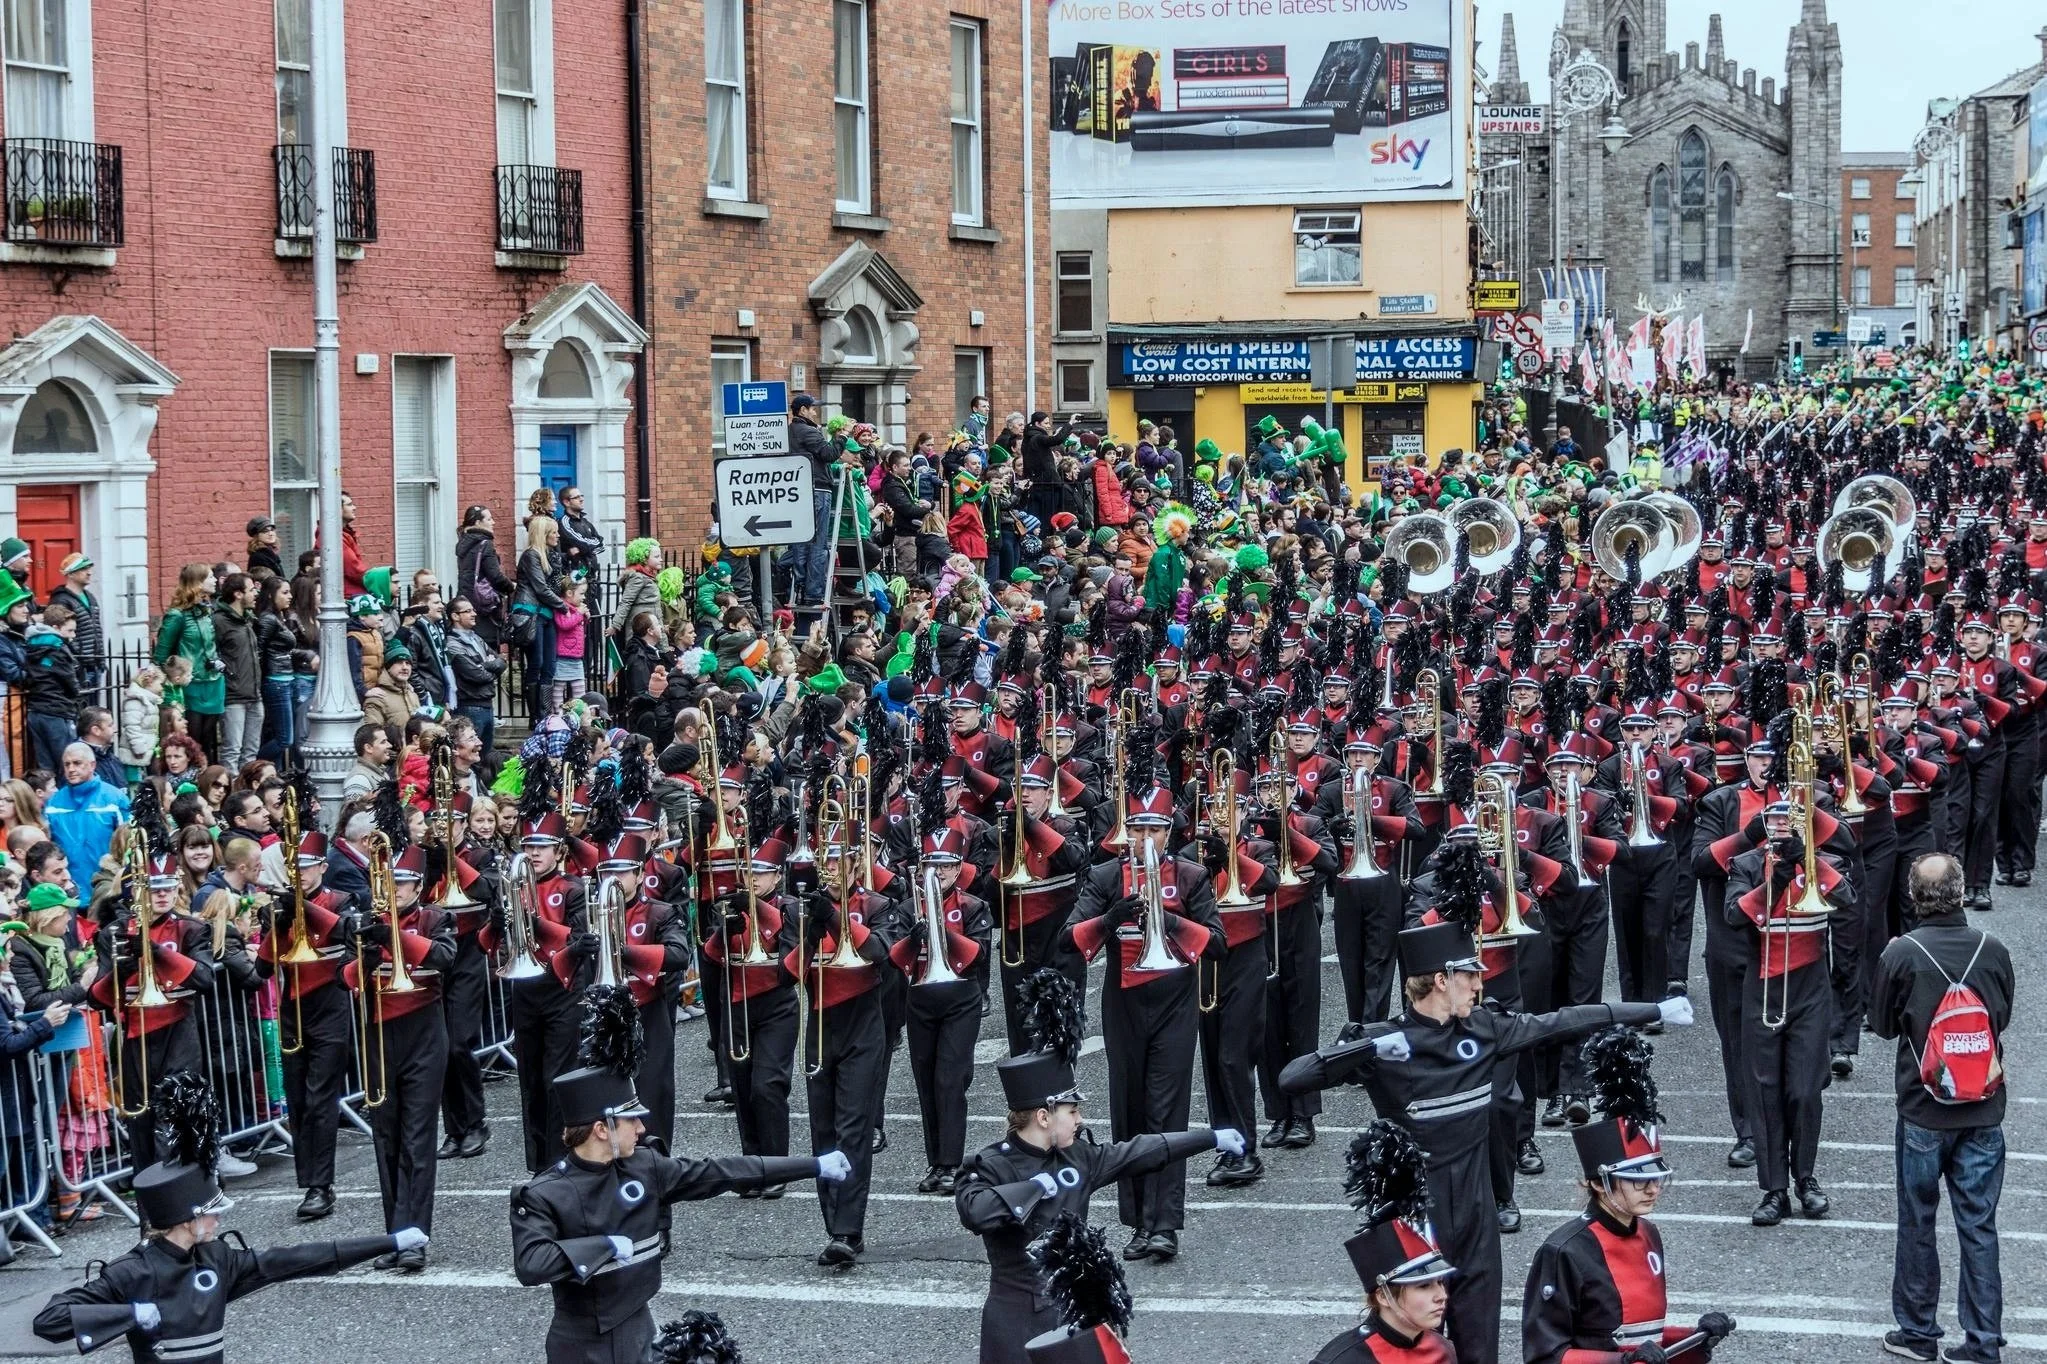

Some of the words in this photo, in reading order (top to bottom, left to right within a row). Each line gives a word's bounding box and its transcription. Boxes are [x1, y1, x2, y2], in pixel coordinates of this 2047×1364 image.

[1060, 3, 1111, 21] More
[1118, 2, 1154, 20] Box
[1160, 0, 1205, 18] Sets
[1211, 0, 1233, 17] of
[1238, 0, 1272, 16] the
[1278, 0, 1336, 15] latest
[1342, 0, 1408, 12] shows
[1191, 53, 1269, 74] GIRLS
[1408, 100, 1446, 117] BONES
[1481, 108, 1541, 118] LOUNGE
[1482, 121, 1541, 132] UPSTAIRS
[1371, 133, 1431, 170] sky
[1381, 305, 1405, 313] GRANBY
[1408, 304, 1423, 312] LANE
[1186, 342, 1233, 355] HIGH
[1239, 341, 1295, 355] SPEED
[1395, 338, 1462, 353] ACCESS
[1132, 359, 1176, 372] LOW
[1182, 358, 1231, 371] COST
[1402, 355, 1463, 369] CALLS
[1523, 356, 1537, 367] 50
[1134, 374, 1155, 382] FAX
[1168, 373, 1253, 382] PHOTOCOPYING
[1270, 372, 1292, 381] CV's
[1407, 370, 1463, 380] SCANNING
[1398, 384, 1424, 400] yes!
[731, 420, 751, 429] Luan
[757, 419, 783, 428] Domh
[741, 432, 753, 441] 24
[733, 443, 756, 451] MON
[762, 441, 782, 450] SUN
[729, 465, 803, 486] Rampaí
[732, 487, 800, 506] RAMPS
[1944, 1032, 1988, 1042] owasso
